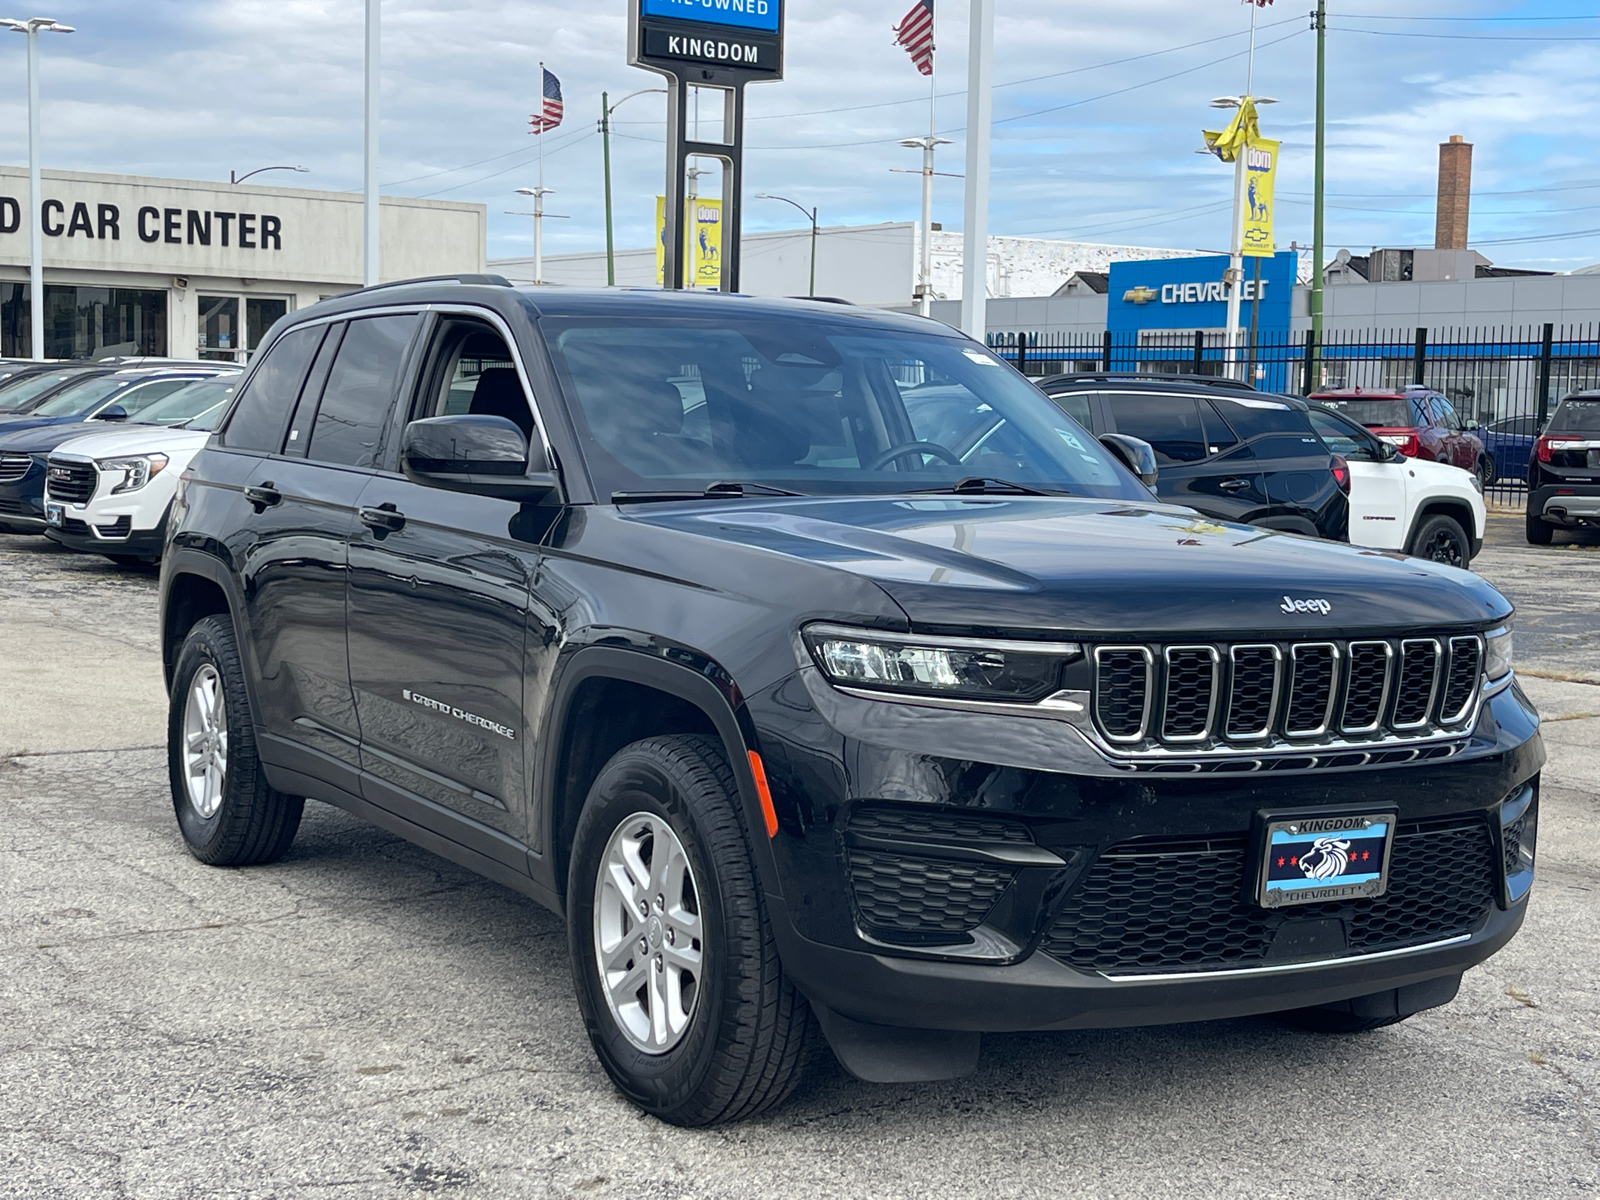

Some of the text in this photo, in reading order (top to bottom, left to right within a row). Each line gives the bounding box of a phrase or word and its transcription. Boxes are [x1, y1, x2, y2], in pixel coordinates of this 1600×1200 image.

[659, 0, 768, 15] -OWNED
[668, 36, 758, 63] KINGDOM
[1248, 146, 1272, 171] dom
[698, 205, 719, 223] dom
[41, 199, 120, 240] CAR
[138, 206, 282, 250] CENTER
[1280, 595, 1332, 615] Jeep
[412, 693, 515, 740] GRAND CHEROKEE
[1300, 816, 1366, 833] KINGDOM
[1290, 886, 1357, 901] CHEVROLET
